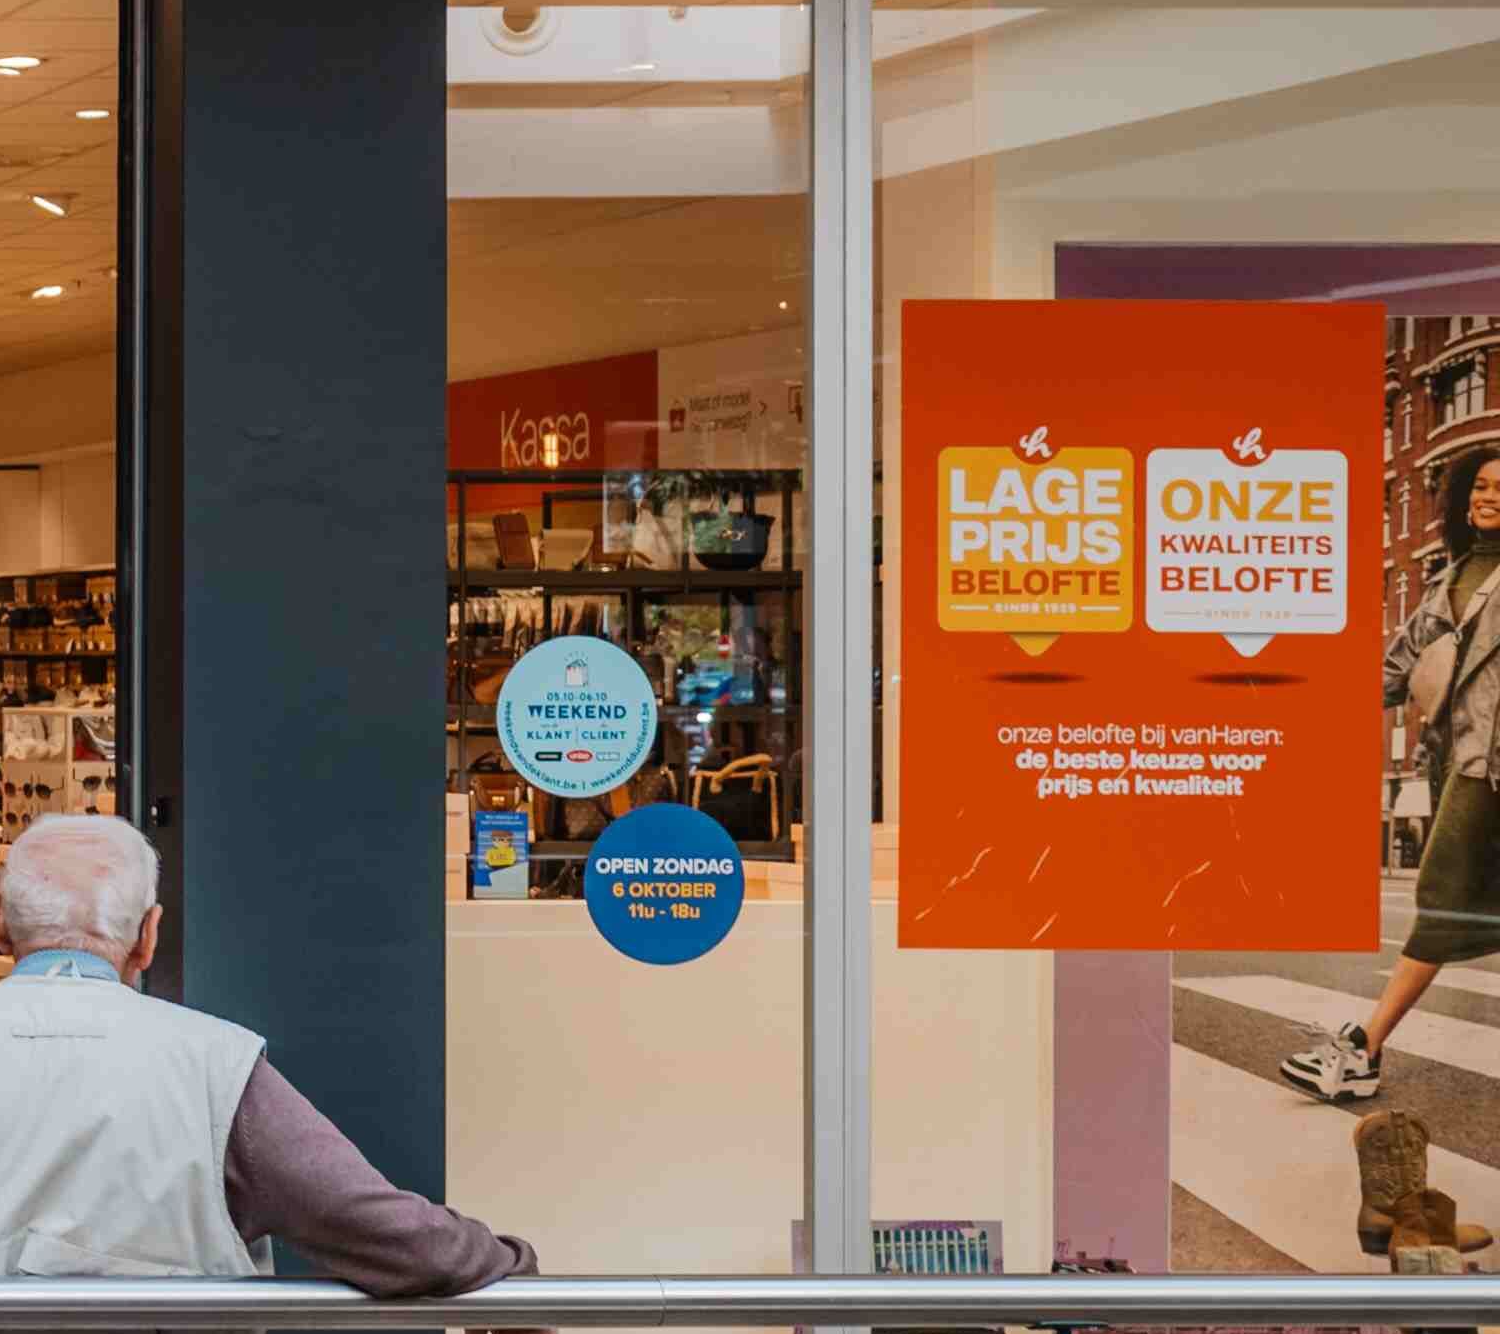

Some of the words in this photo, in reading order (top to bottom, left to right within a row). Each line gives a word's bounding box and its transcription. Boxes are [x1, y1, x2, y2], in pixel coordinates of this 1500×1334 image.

[501, 408, 591, 468] Kassa
[950, 468, 1123, 514] LAGE
[1160, 478, 1335, 523] ONZE
[950, 519, 1123, 565] PRIJS
[1159, 534, 1334, 556] KWALITEITS
[950, 569, 1122, 596] BELOFTE
[1160, 566, 1334, 594] BELOFTE
[527, 704, 627, 719] WEEKEND
[526, 730, 573, 740] KLANT
[581, 730, 628, 740] CLIENT
[998, 727, 1052, 745] onze
[1058, 723, 1136, 745] belofte
[1141, 723, 1166, 749] bij
[1171, 724, 1285, 747] vanHaren:
[1015, 748, 1048, 770] de
[1053, 748, 1126, 770] beste
[1130, 748, 1205, 770] keuze
[1209, 753, 1267, 771] voor
[1038, 773, 1093, 799] prijs
[1098, 777, 1129, 796] en
[1134, 774, 1244, 797] kwaliteit
[595, 857, 648, 875] OPEN
[652, 857, 735, 875] ZONDAG
[612, 882, 626, 898] 6
[628, 882, 717, 898] OKTOBER
[628, 903, 656, 919] 11u
[670, 903, 701, 919] 18u
